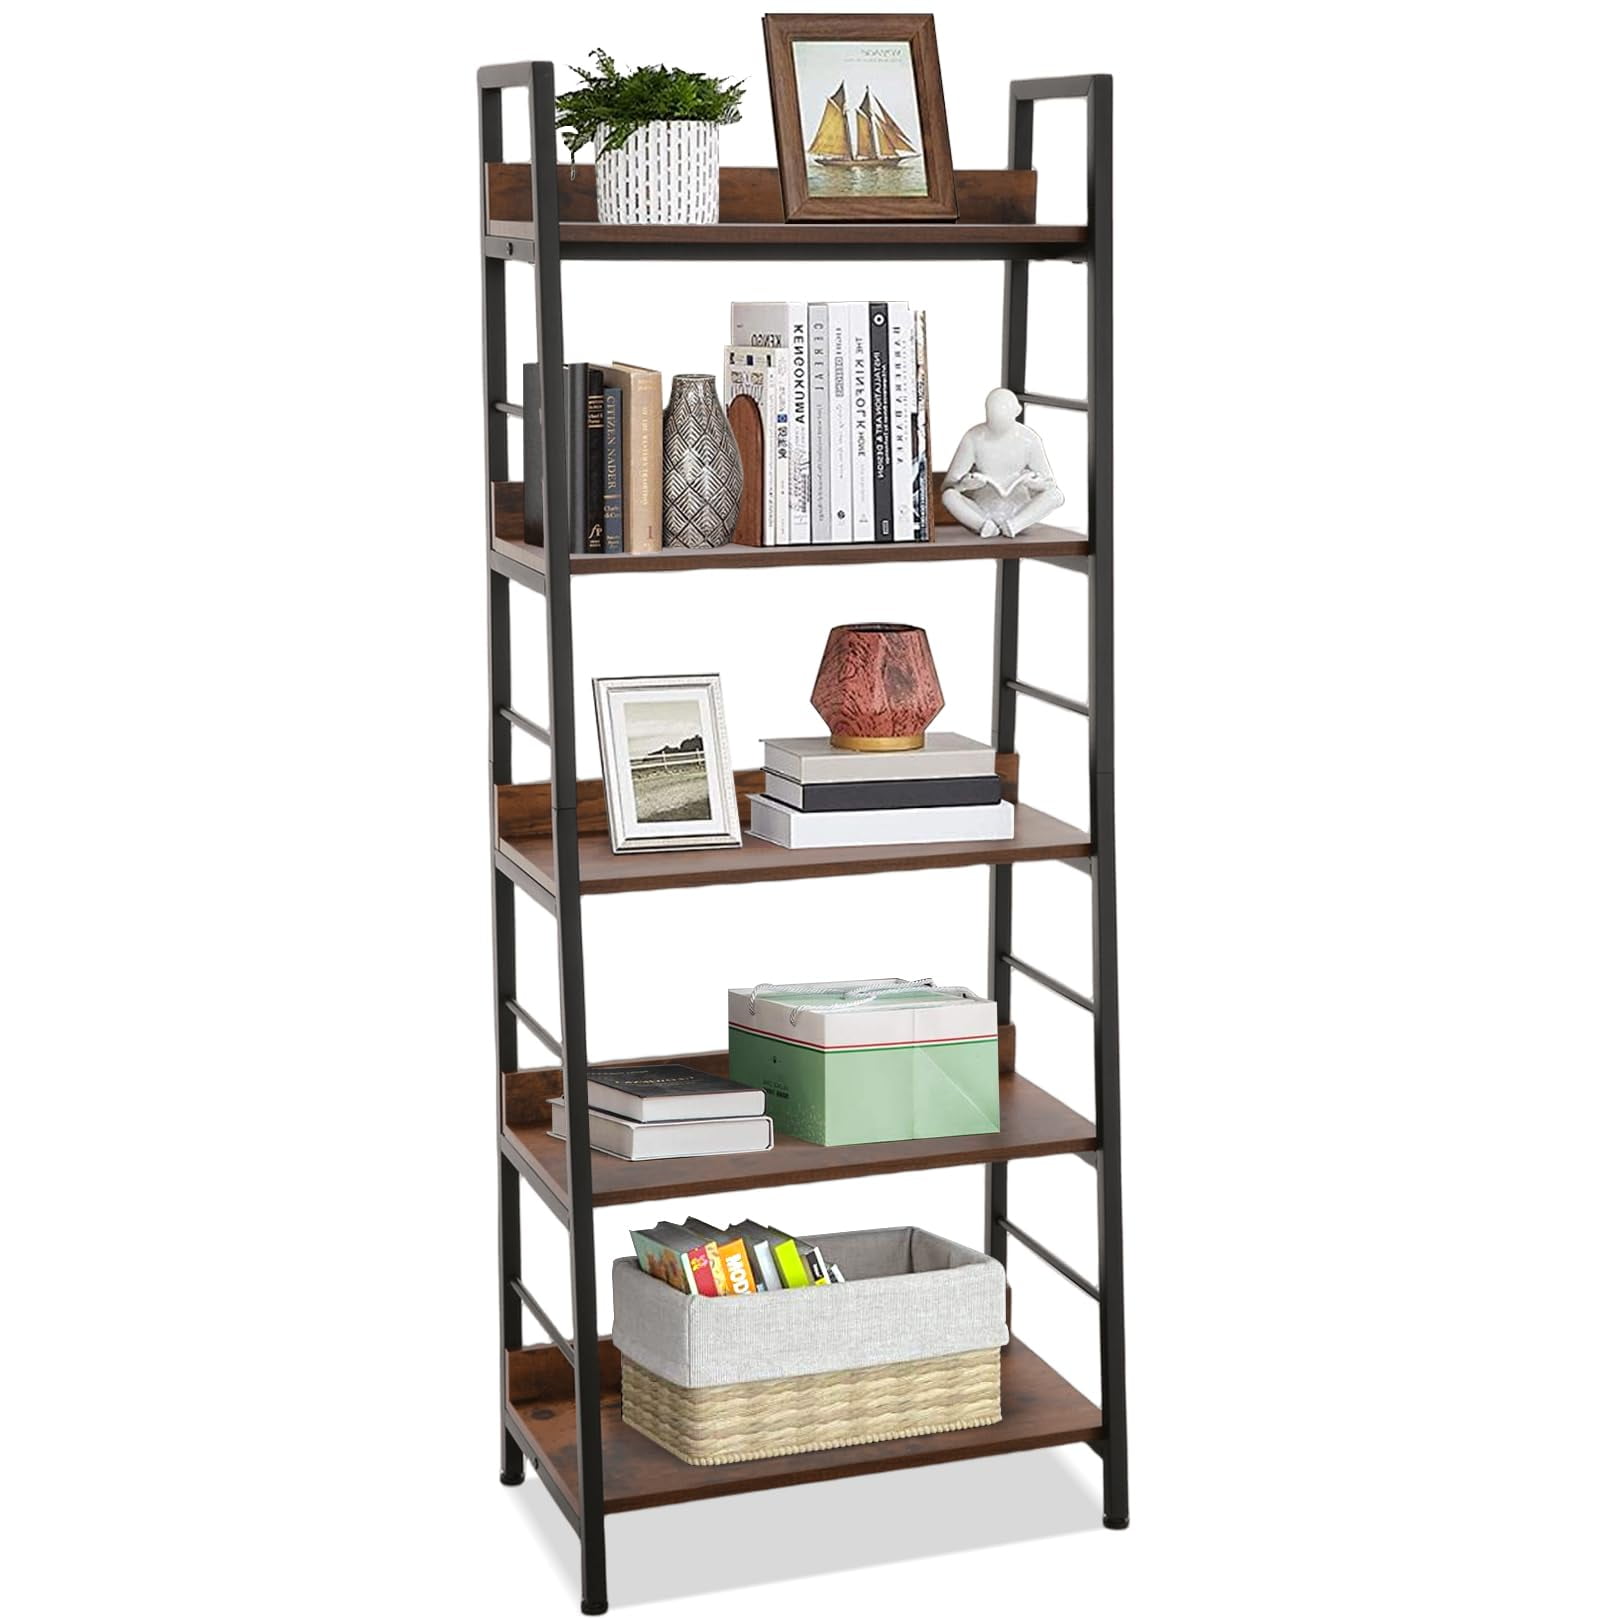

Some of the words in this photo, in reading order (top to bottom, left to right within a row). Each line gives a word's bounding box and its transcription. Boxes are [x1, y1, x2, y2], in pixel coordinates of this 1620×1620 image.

[606, 396, 616, 445] CITIZEN
[607, 448, 617, 489] NADER
[725, 1253, 752, 1296] MOD
